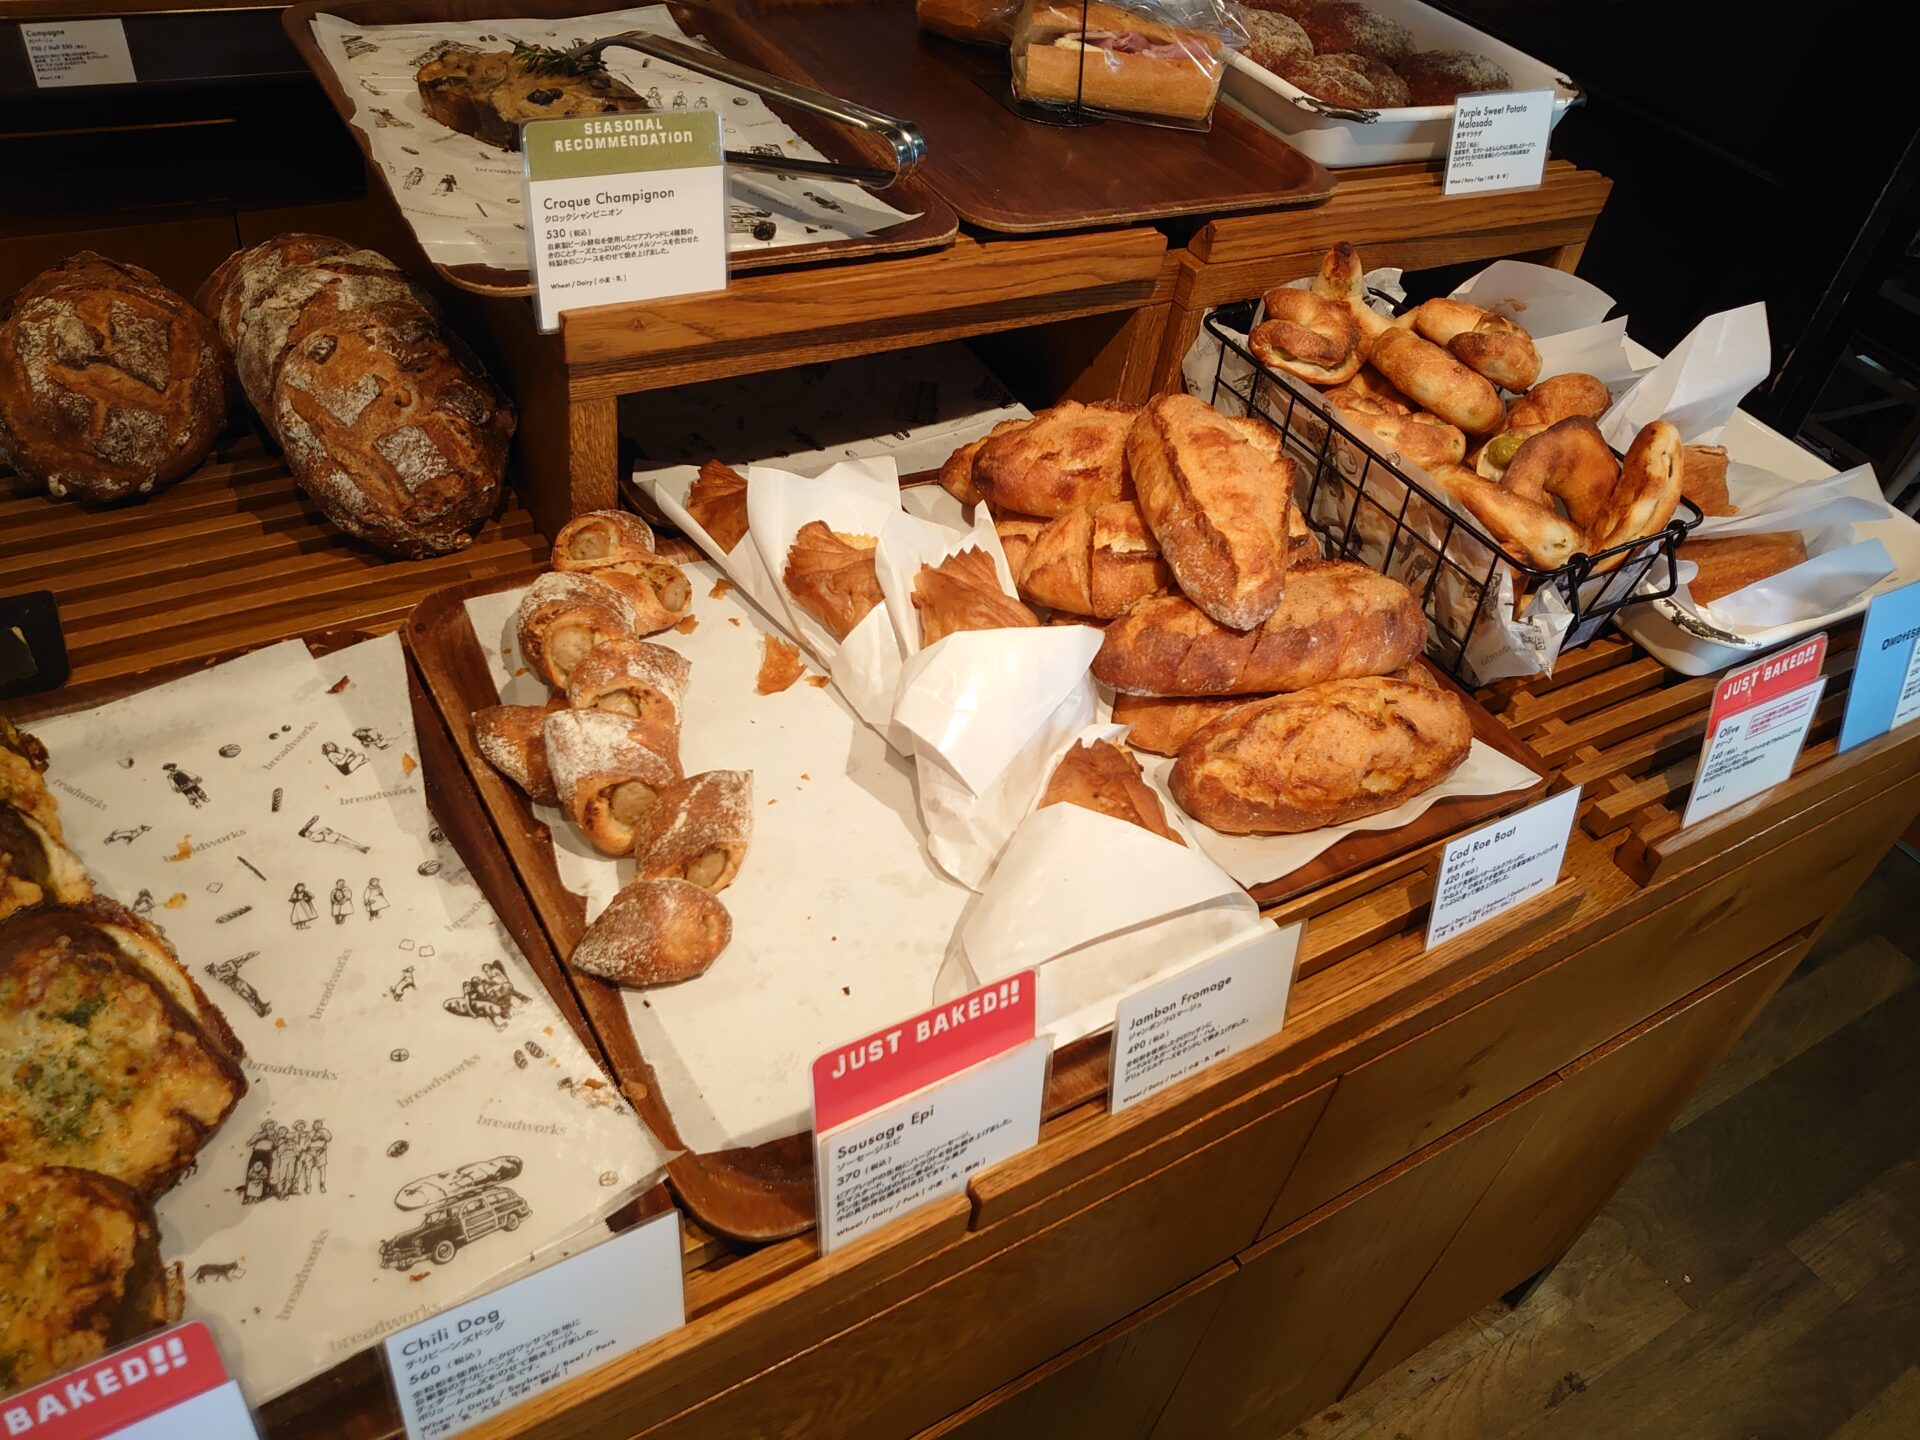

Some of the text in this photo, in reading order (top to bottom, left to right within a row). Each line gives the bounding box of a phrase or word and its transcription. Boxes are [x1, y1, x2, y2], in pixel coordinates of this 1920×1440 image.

[1458, 118, 1492, 129] Malasada
[1460, 105, 1527, 119] Purple Sweet Potato
[584, 117, 663, 135] SEASONAL
[555, 130, 693, 152] RECOMMENDATION
[1455, 141, 1466, 149] 320
[544, 190, 674, 210] Croque Champignon
[546, 228, 566, 239] 530
[1723, 644, 1817, 700] JUST BAKED!!
[1720, 726, 1740, 738] Olive
[262, 719, 319, 771] breadworks
[1450, 826, 1516, 862] Cod Roe Boat
[1445, 873, 1459, 885] 420
[308, 948, 353, 1021] breadworks
[1130, 977, 1231, 1030] Jambon Fromage
[831, 979, 1021, 1080] JUST BAKED!!
[1128, 1040, 1145, 1054] 490
[247, 1058, 339, 1081] breadworks
[397, 1053, 482, 1109] breadworks
[476, 1113, 567, 1137] breadworks
[838, 1106, 933, 1158] Sausage Epi
[838, 1169, 860, 1186] 370
[276, 1227, 331, 1322] breadworks
[402, 1310, 499, 1356] Chili Dog
[3, 1336, 188, 1436] BAKED!!
[410, 1366, 440, 1385] 560
